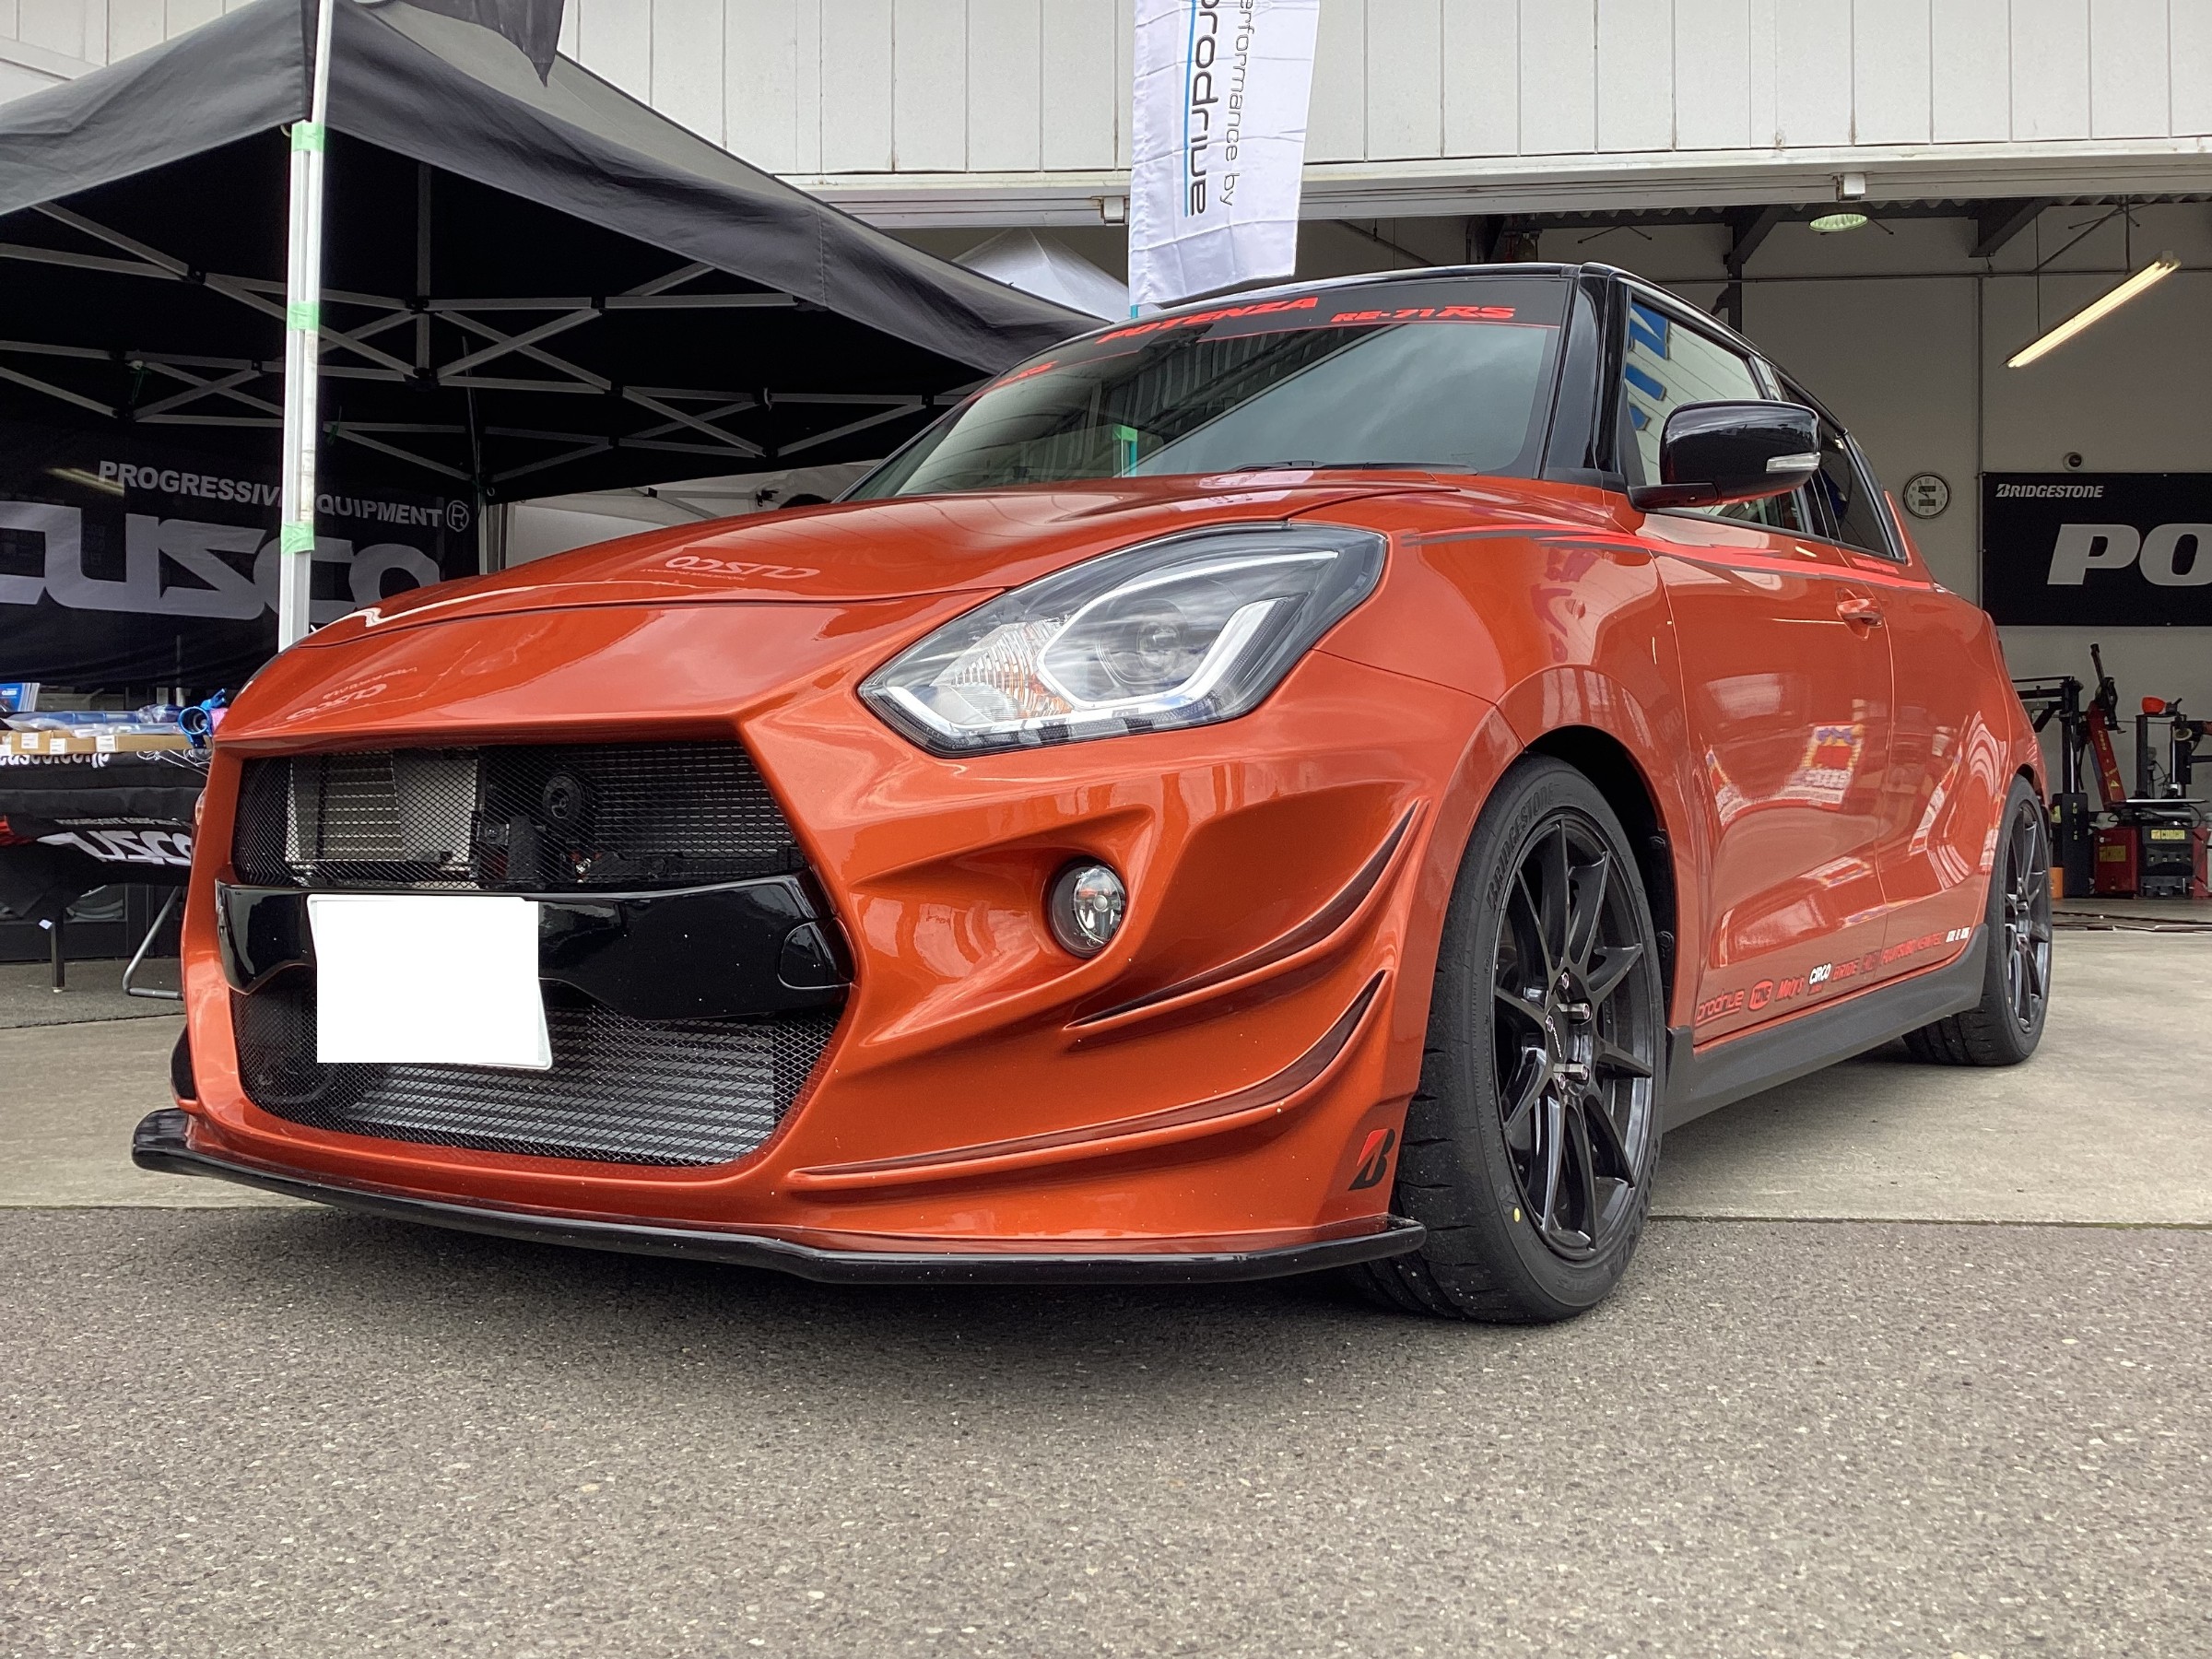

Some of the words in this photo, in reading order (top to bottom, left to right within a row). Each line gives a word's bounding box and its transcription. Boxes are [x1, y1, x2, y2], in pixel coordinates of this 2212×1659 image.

[1219, 172, 1241, 206] by
[1095, 297, 1319, 345] POTENZA
[98, 460, 282, 508] PROGRESSIV
[313, 493, 443, 528] QUIPMENT
[1995, 484, 2104, 498] BRIDGESTONE
[2046, 523, 2212, 586] PO
